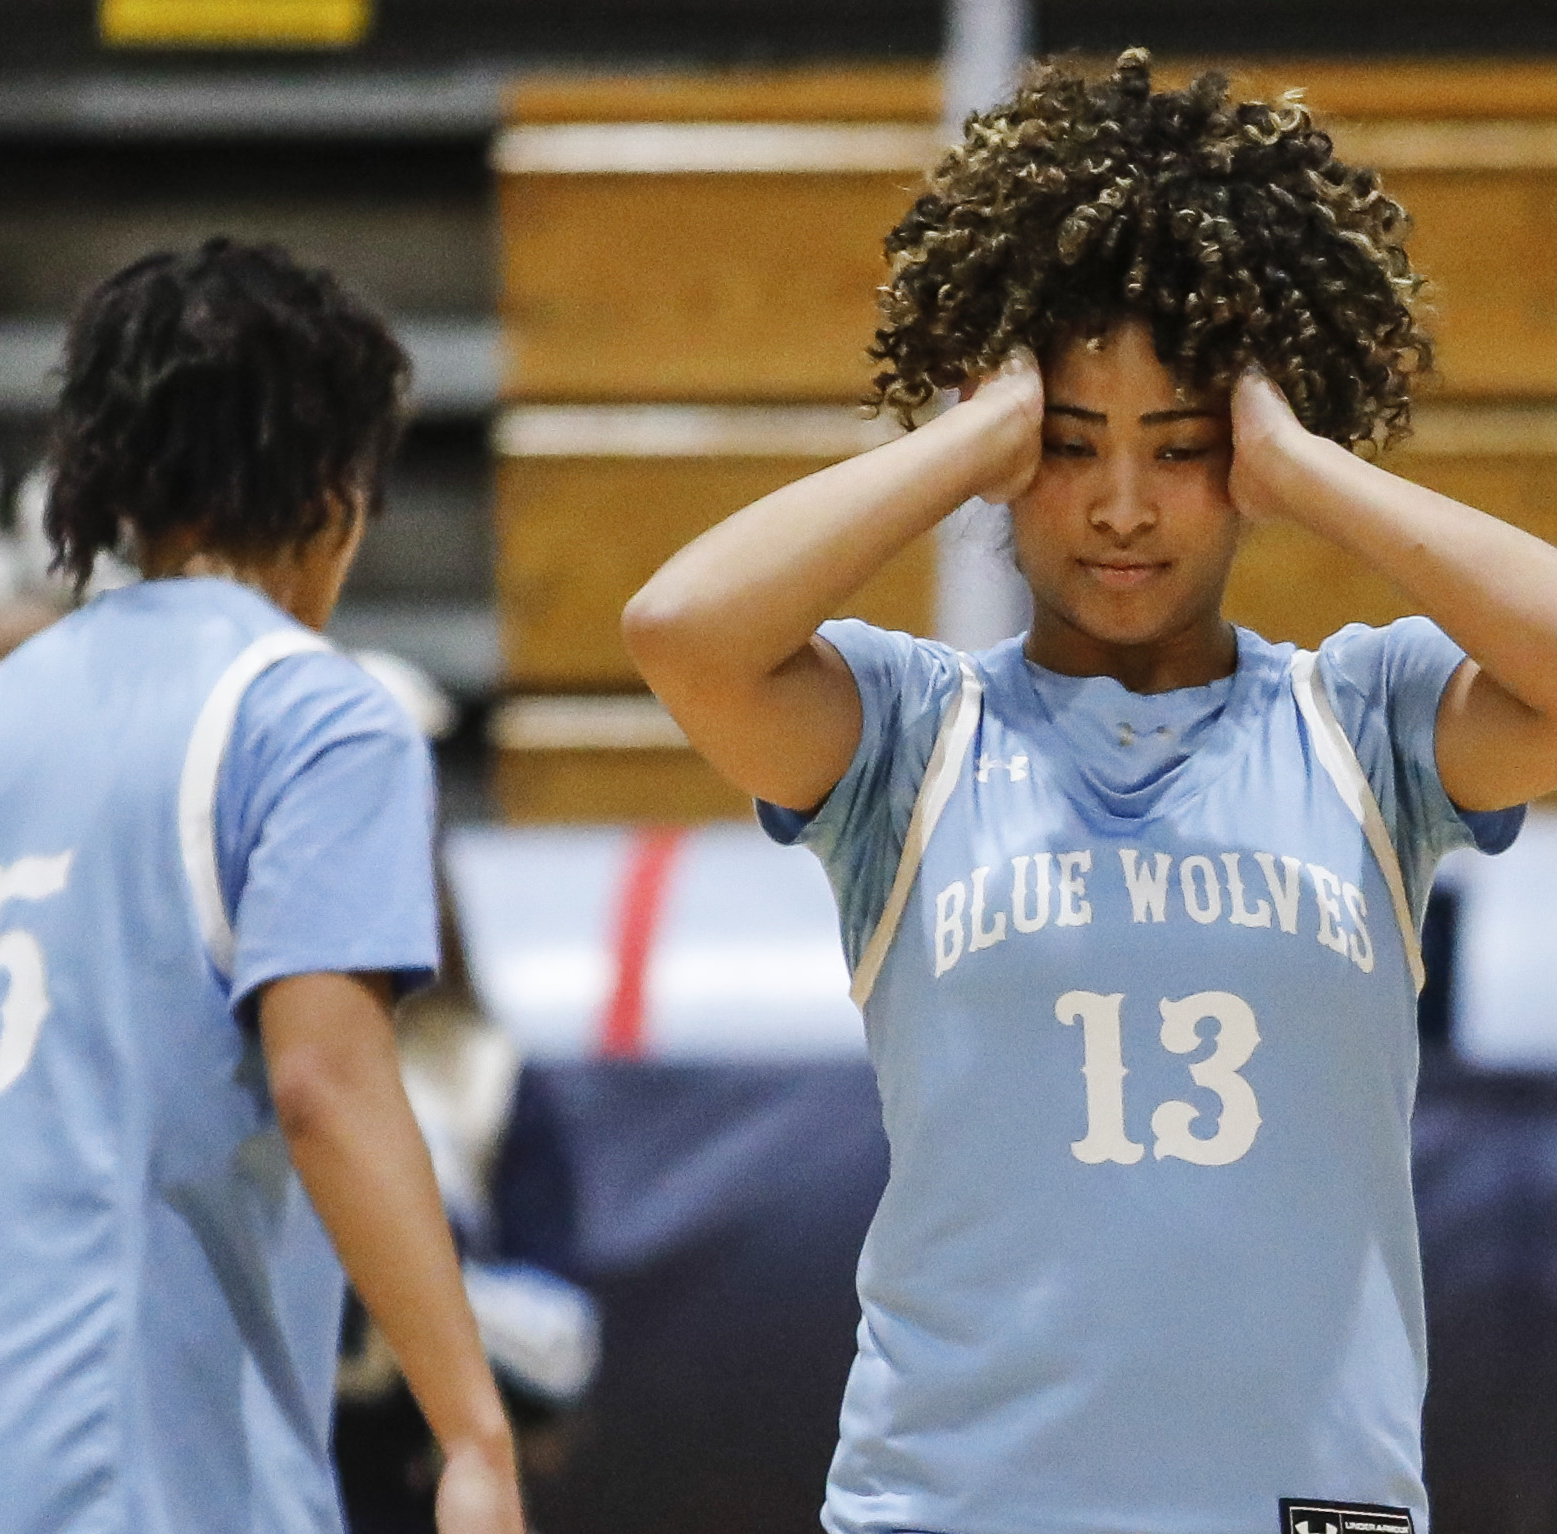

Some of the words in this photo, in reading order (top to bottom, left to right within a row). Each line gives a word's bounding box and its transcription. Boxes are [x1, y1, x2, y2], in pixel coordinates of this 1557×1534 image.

[933, 850, 1092, 978] BLUE
[1120, 848, 1374, 974] WOLVES
[1054, 990, 1263, 1166] 13
